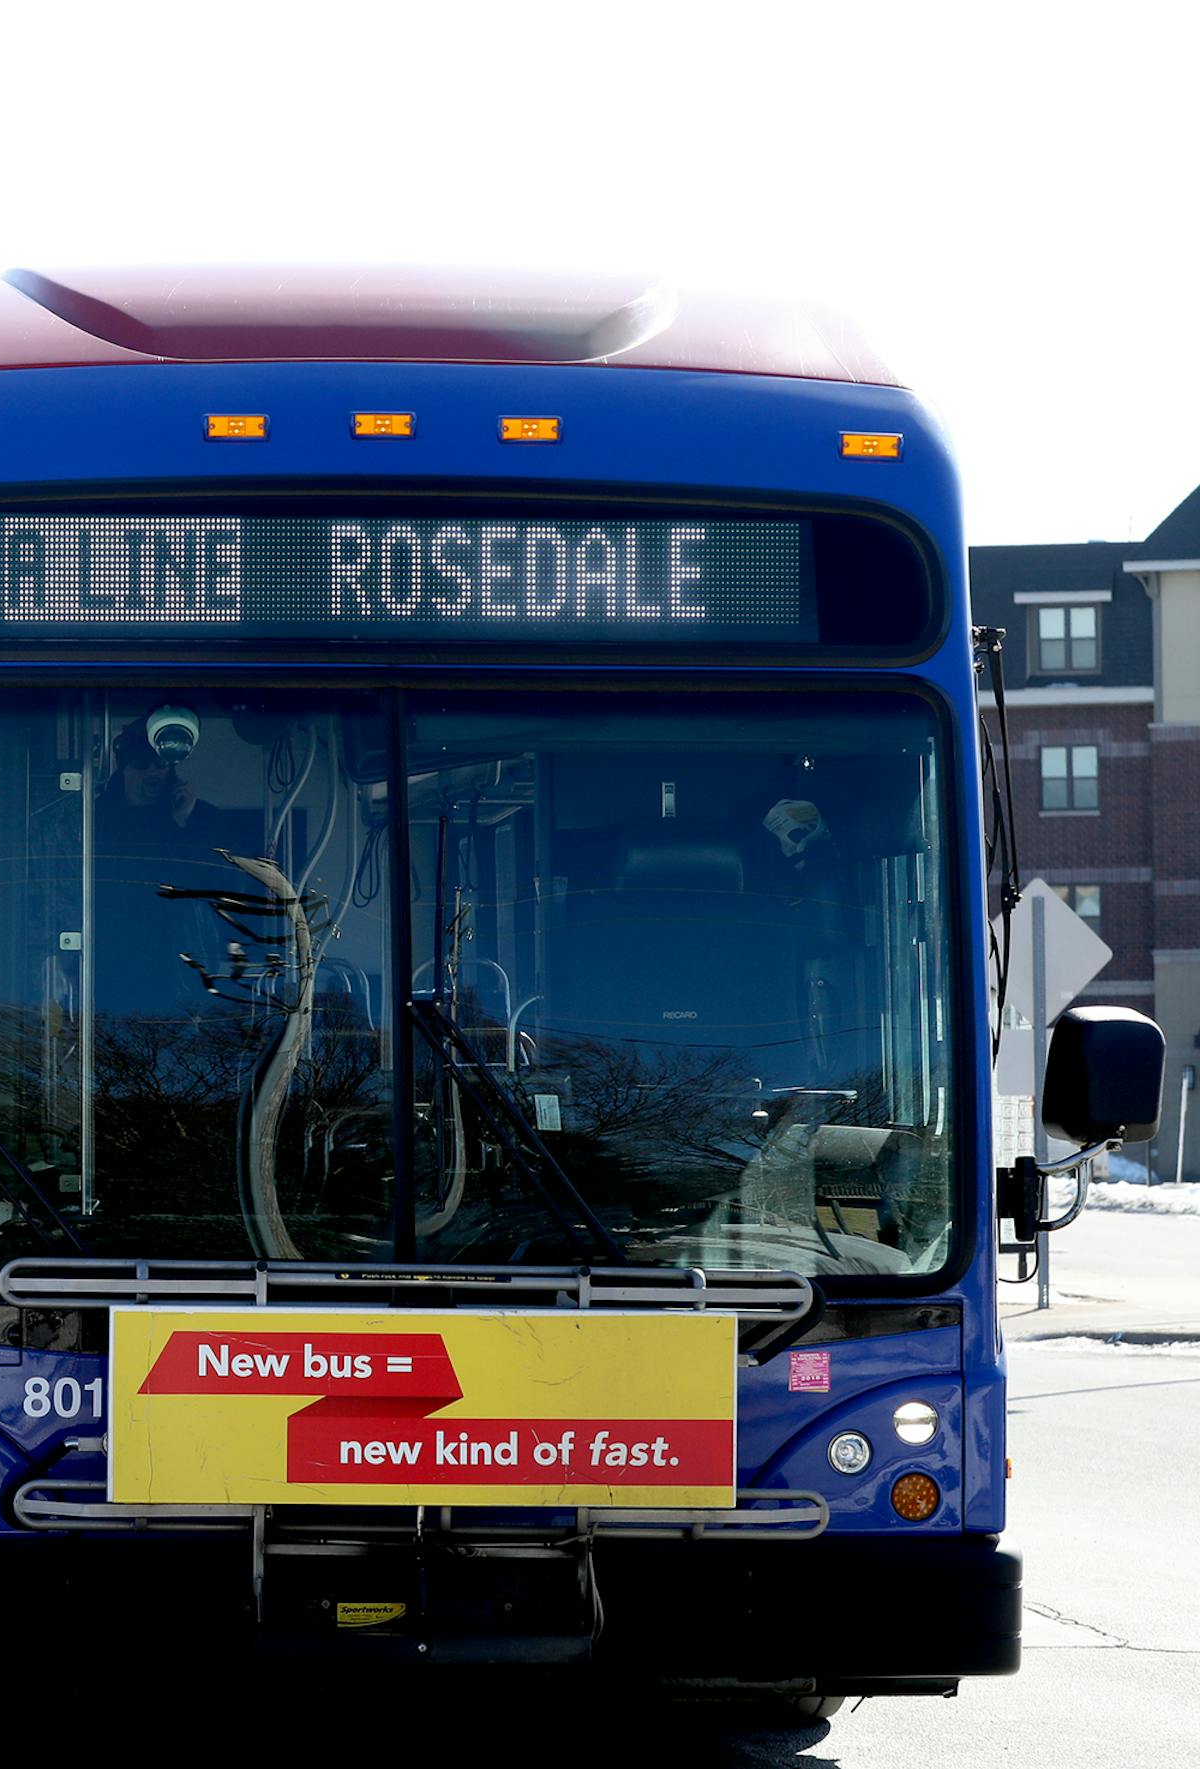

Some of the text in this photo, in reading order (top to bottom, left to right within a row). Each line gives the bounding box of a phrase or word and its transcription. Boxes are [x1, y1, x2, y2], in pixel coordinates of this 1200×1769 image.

[331, 524, 706, 618] ROSEDALE
[197, 1343, 291, 1378] New
[303, 1343, 373, 1379] bus
[23, 1376, 103, 1418] 801
[339, 1430, 680, 1467] new kind of fast.
[340, 1605, 394, 1615] Sportworks
